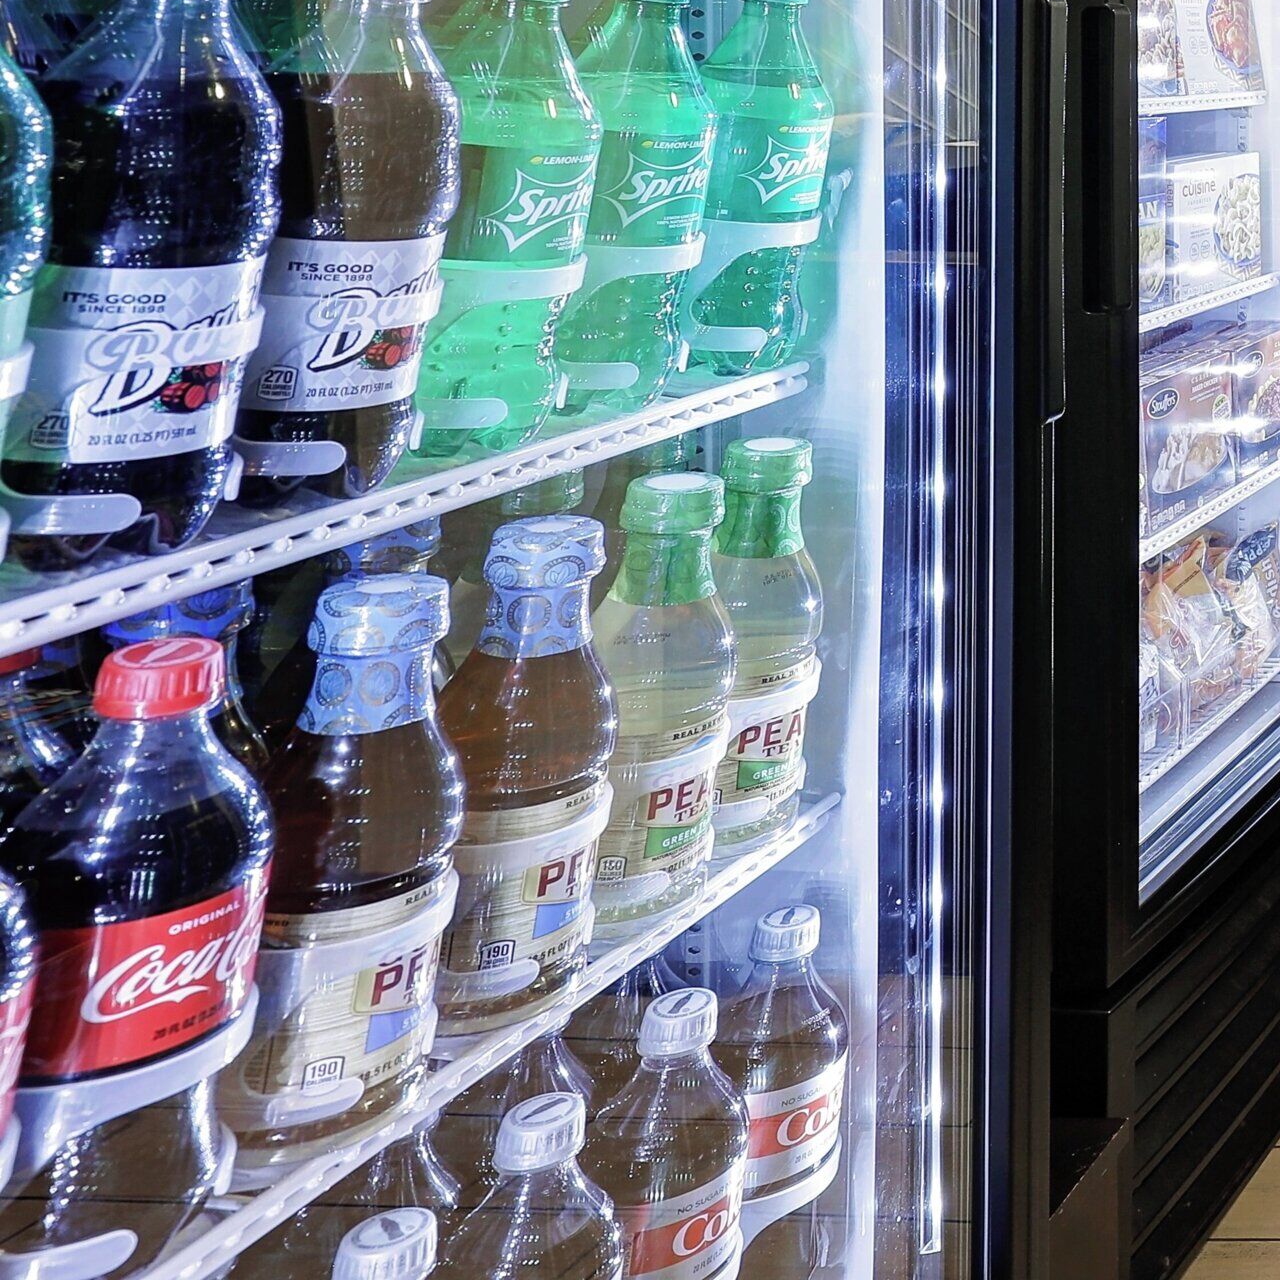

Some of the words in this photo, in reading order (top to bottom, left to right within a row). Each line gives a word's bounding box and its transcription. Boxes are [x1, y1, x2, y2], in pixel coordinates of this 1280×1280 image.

[619, 166, 707, 202] Sprite
[1182, 180, 1217, 198] cuisine
[287, 261, 321, 276] IT'S
[324, 263, 375, 275] GOOD
[300, 272, 342, 283] SINCE
[344, 273, 373, 283] 1898
[62, 290, 103, 305] IT'S
[105, 292, 168, 306] GOOD
[78, 303, 129, 315] SINCE
[131, 302, 166, 314] 1898
[263, 368, 293, 385] 270
[305, 386, 317, 398] 20
[761, 672, 787, 685] REAL
[673, 726, 699, 742] REAL
[753, 763, 788, 781] GREEN
[566, 791, 592, 810] REAL
[662, 827, 697, 849] GREEN
[602, 859, 622, 872] 150
[404, 887, 435, 906] REAL
[168, 900, 241, 937] ORIGINAL
[482, 944, 509, 961] 190
[309, 1059, 338, 1081] 190
[781, 1095, 797, 1108] NO
[677, 1202, 693, 1216] NO
